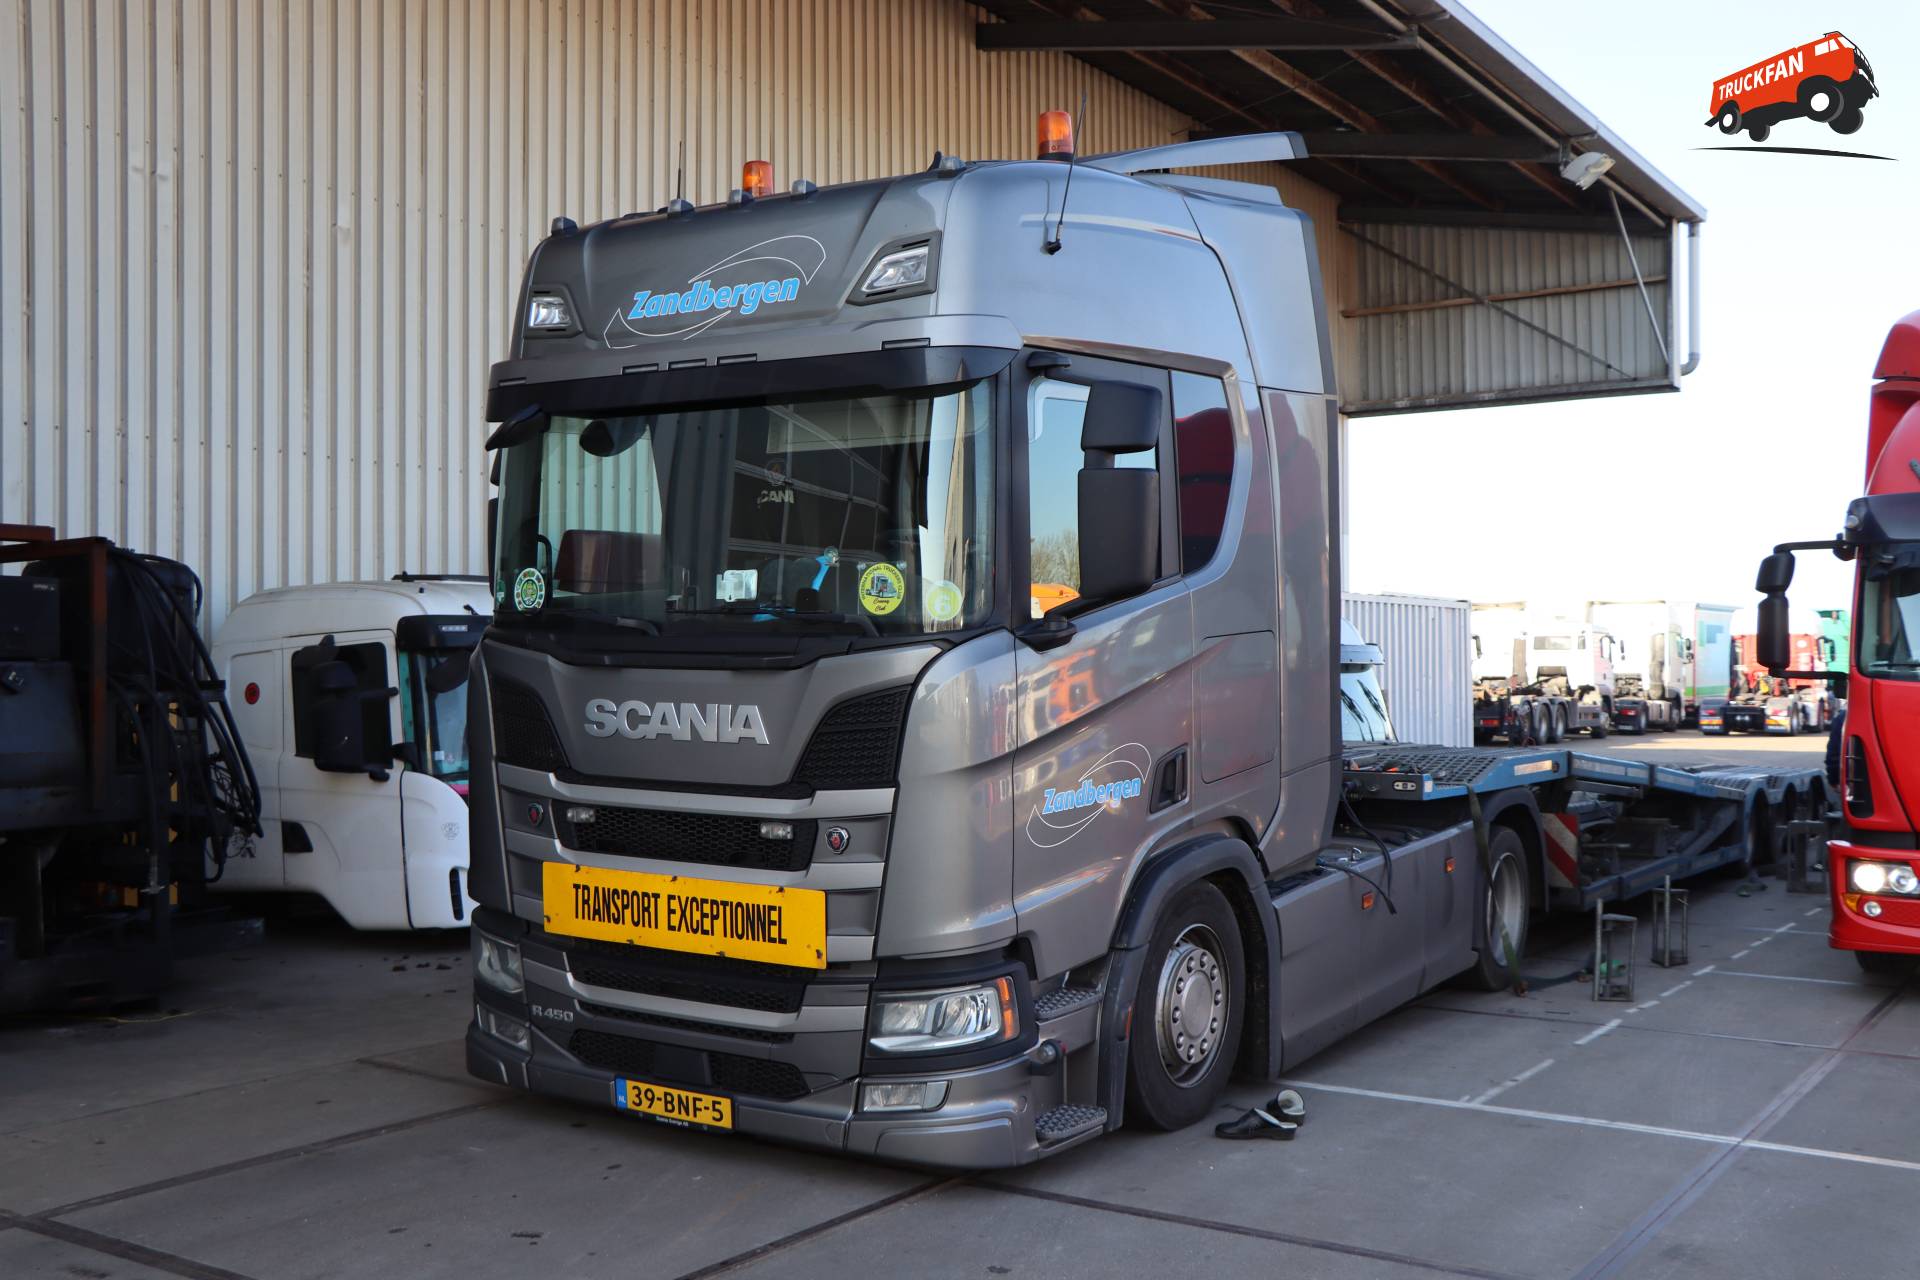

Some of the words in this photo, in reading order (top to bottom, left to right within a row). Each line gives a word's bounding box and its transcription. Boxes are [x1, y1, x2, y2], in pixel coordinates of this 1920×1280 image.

[627, 277, 800, 315] Zandbergen
[584, 698, 770, 745] SCANIA
[1042, 778, 1142, 815] Zandbergen
[572, 883, 660, 930] TRANSPORT
[667, 894, 788, 945] EXCEPTIONNEL
[532, 1004, 543, 1017] R
[544, 1008, 574, 1022] 450
[618, 1095, 626, 1104] NL
[631, 1085, 724, 1122] 39-BNF-5
